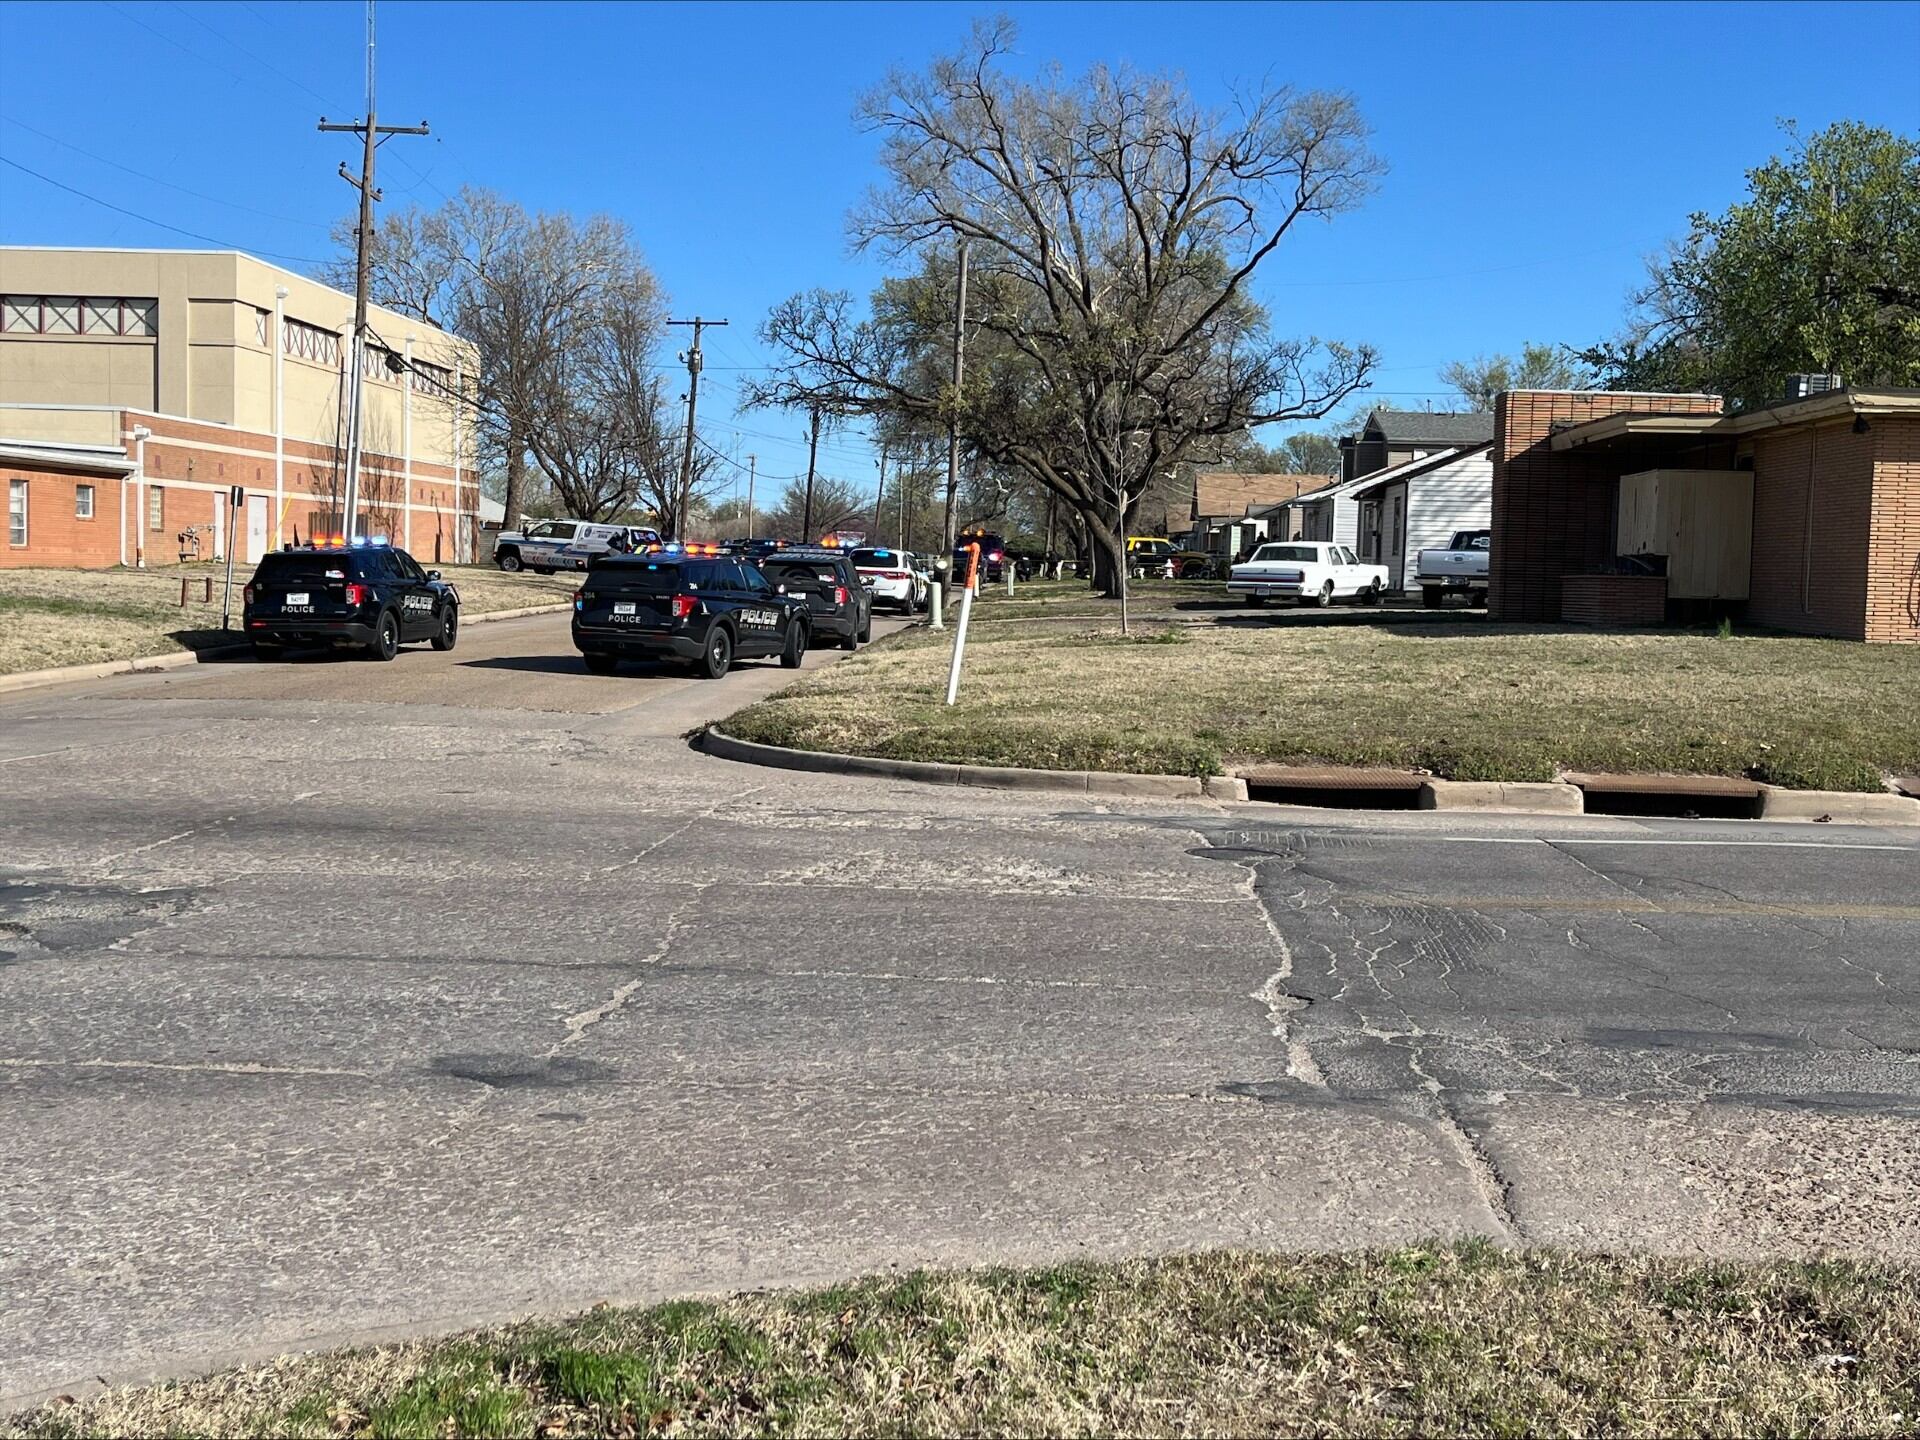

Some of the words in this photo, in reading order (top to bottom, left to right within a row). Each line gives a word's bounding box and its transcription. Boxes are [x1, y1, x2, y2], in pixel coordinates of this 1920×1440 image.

[402, 595, 433, 609] POLICE
[281, 605, 315, 613] POLICE
[608, 614, 641, 624] POLICE
[740, 609, 778, 625] POLICE
